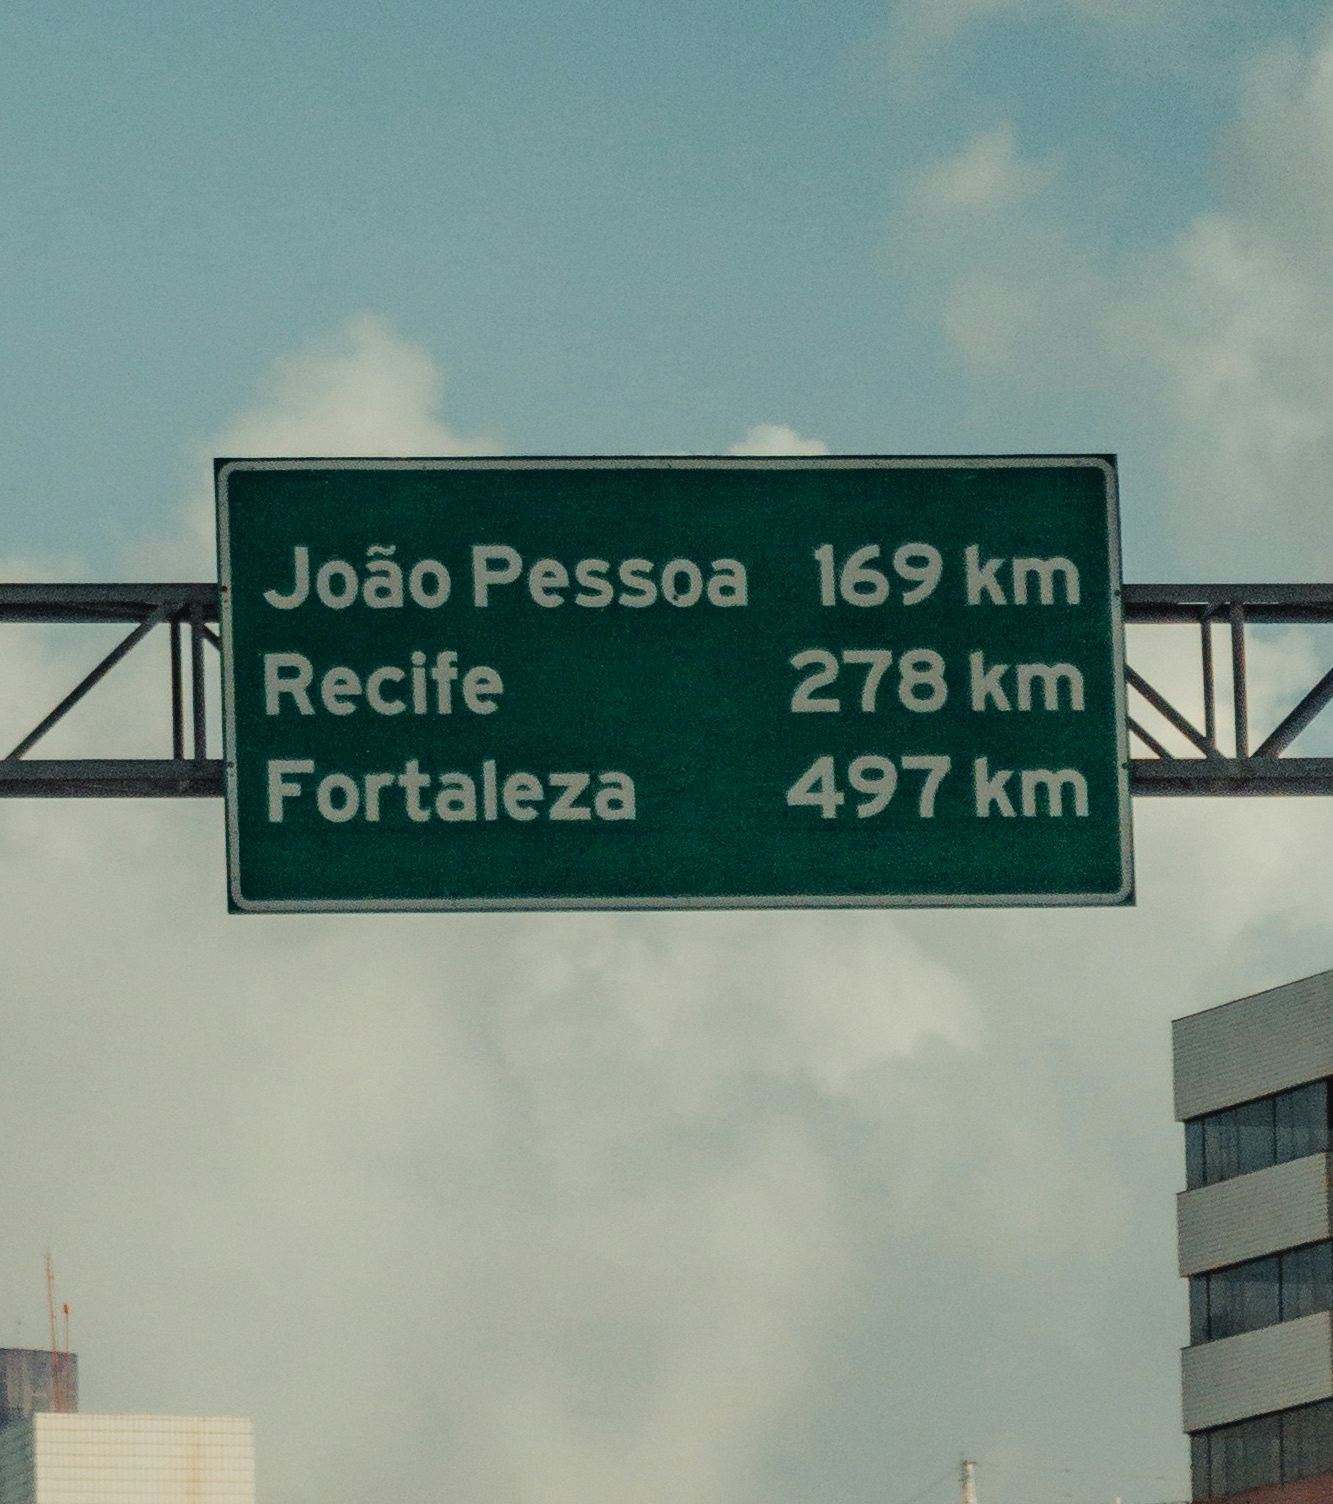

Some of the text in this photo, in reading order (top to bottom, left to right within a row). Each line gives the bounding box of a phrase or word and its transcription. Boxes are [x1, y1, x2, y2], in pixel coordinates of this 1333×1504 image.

[263, 542, 1080, 610] João Pessoa 169 km
[264, 647, 1085, 716] Recife 278 km
[267, 754, 1089, 824] Fortaleza 497 km
